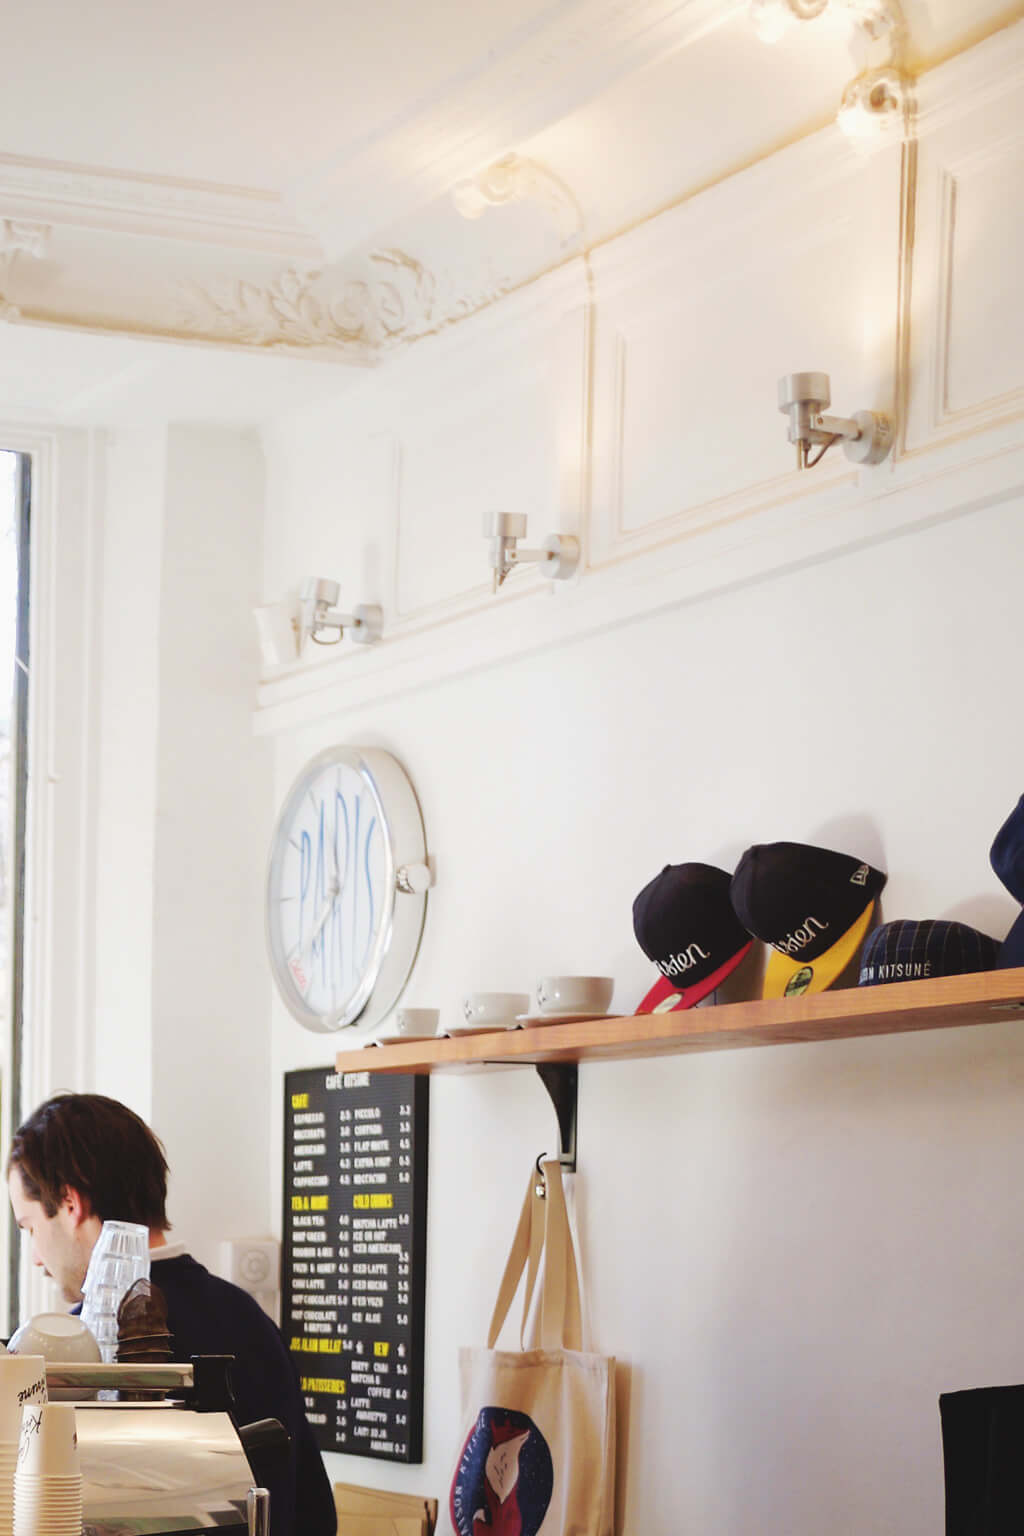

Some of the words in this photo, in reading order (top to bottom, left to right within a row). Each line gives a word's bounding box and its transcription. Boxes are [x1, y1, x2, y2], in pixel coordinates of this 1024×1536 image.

[298, 791, 377, 987] PARIS
[878, 961, 932, 979] KITSUNÉ
[377, 1218, 398, 1229] LATTE
[368, 1263, 388, 1274] LATTE
[306, 1278, 325, 1289] LATTE
[303, 1294, 337, 1306] CHOCOLATE
[303, 1310, 337, 1321] CHOCOLATE
[367, 1386, 392, 1398] COFFEE
[350, 1397, 370, 1409] LATTE
